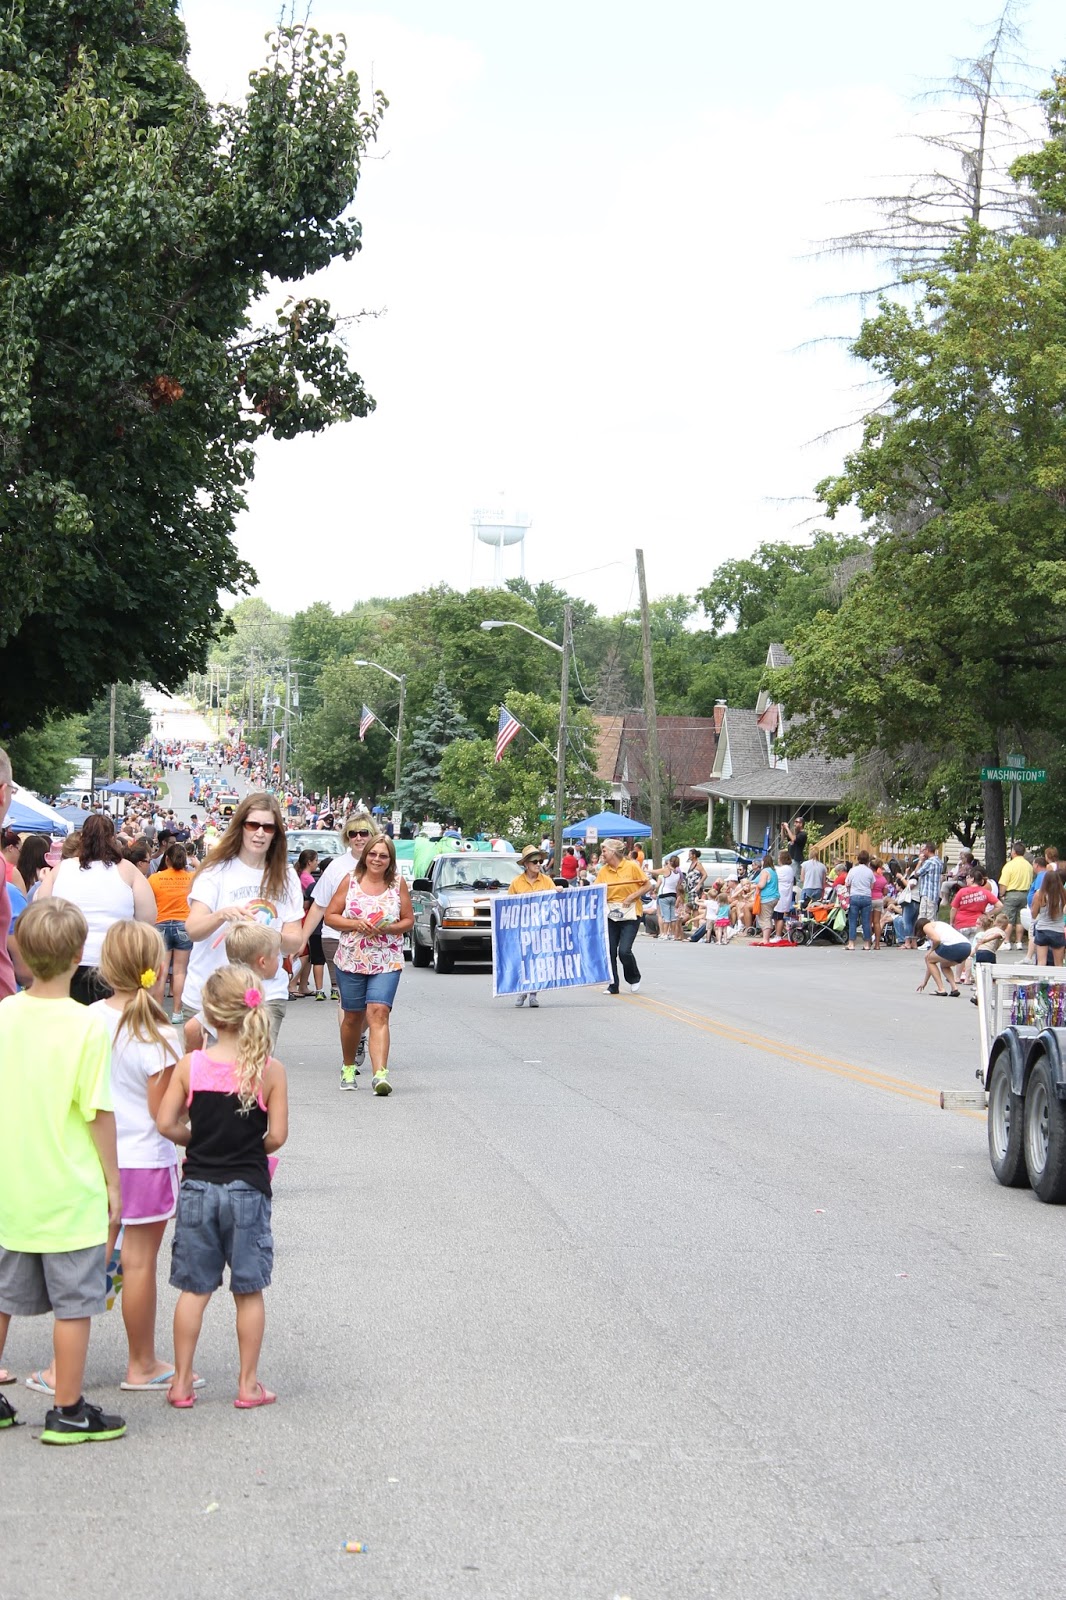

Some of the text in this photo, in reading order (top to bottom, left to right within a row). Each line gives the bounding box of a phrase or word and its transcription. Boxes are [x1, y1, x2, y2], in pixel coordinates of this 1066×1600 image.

[981, 768, 1046, 781] E WASHINGTON ST
[500, 895, 598, 929] MOORESVILLE
[520, 926, 573, 956] PUBLIC
[521, 954, 581, 984] LIBRARY
